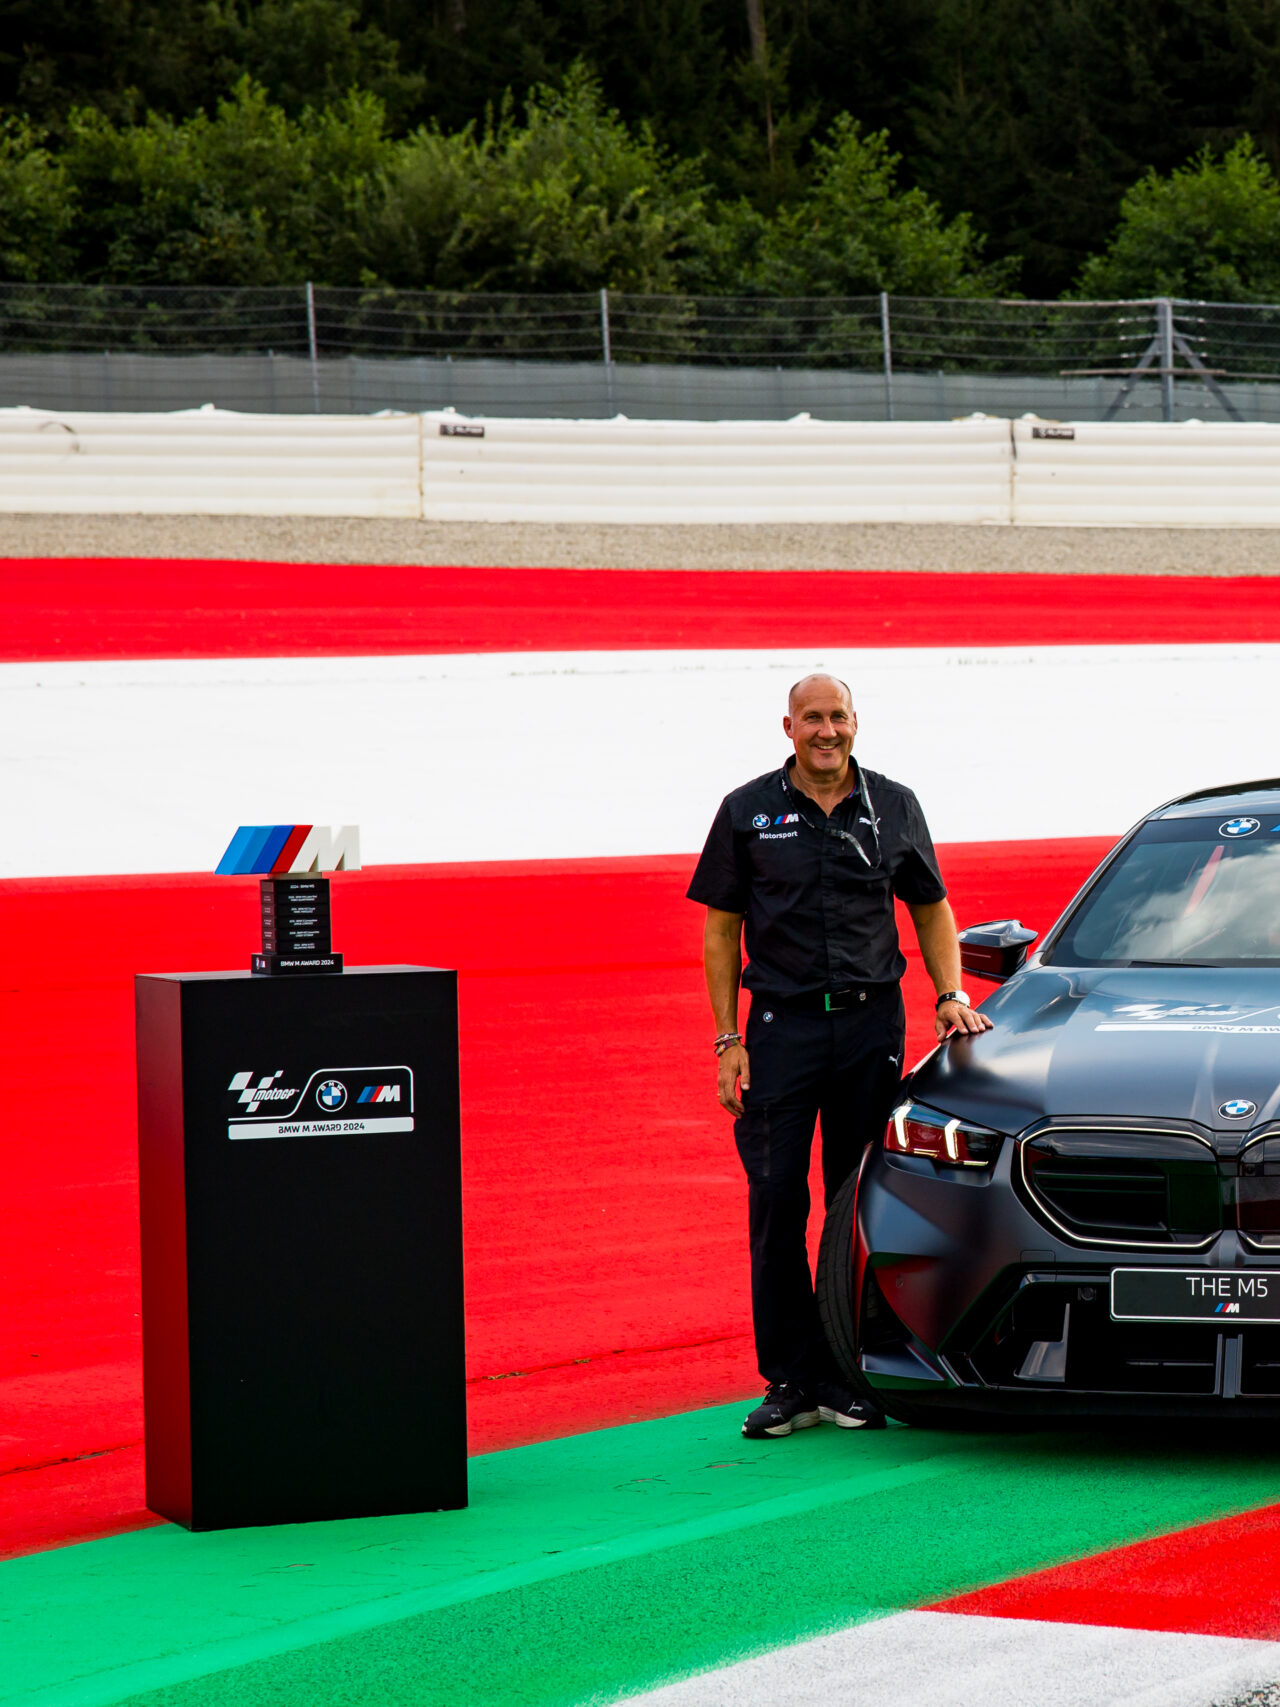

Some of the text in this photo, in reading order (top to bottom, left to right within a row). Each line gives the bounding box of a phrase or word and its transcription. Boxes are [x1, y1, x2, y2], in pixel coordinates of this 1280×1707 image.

[759, 831, 798, 840] Motorsport
[278, 1122, 365, 1134] BMW M AWARD 2024
[1186, 1277, 1268, 1298] THE M5
